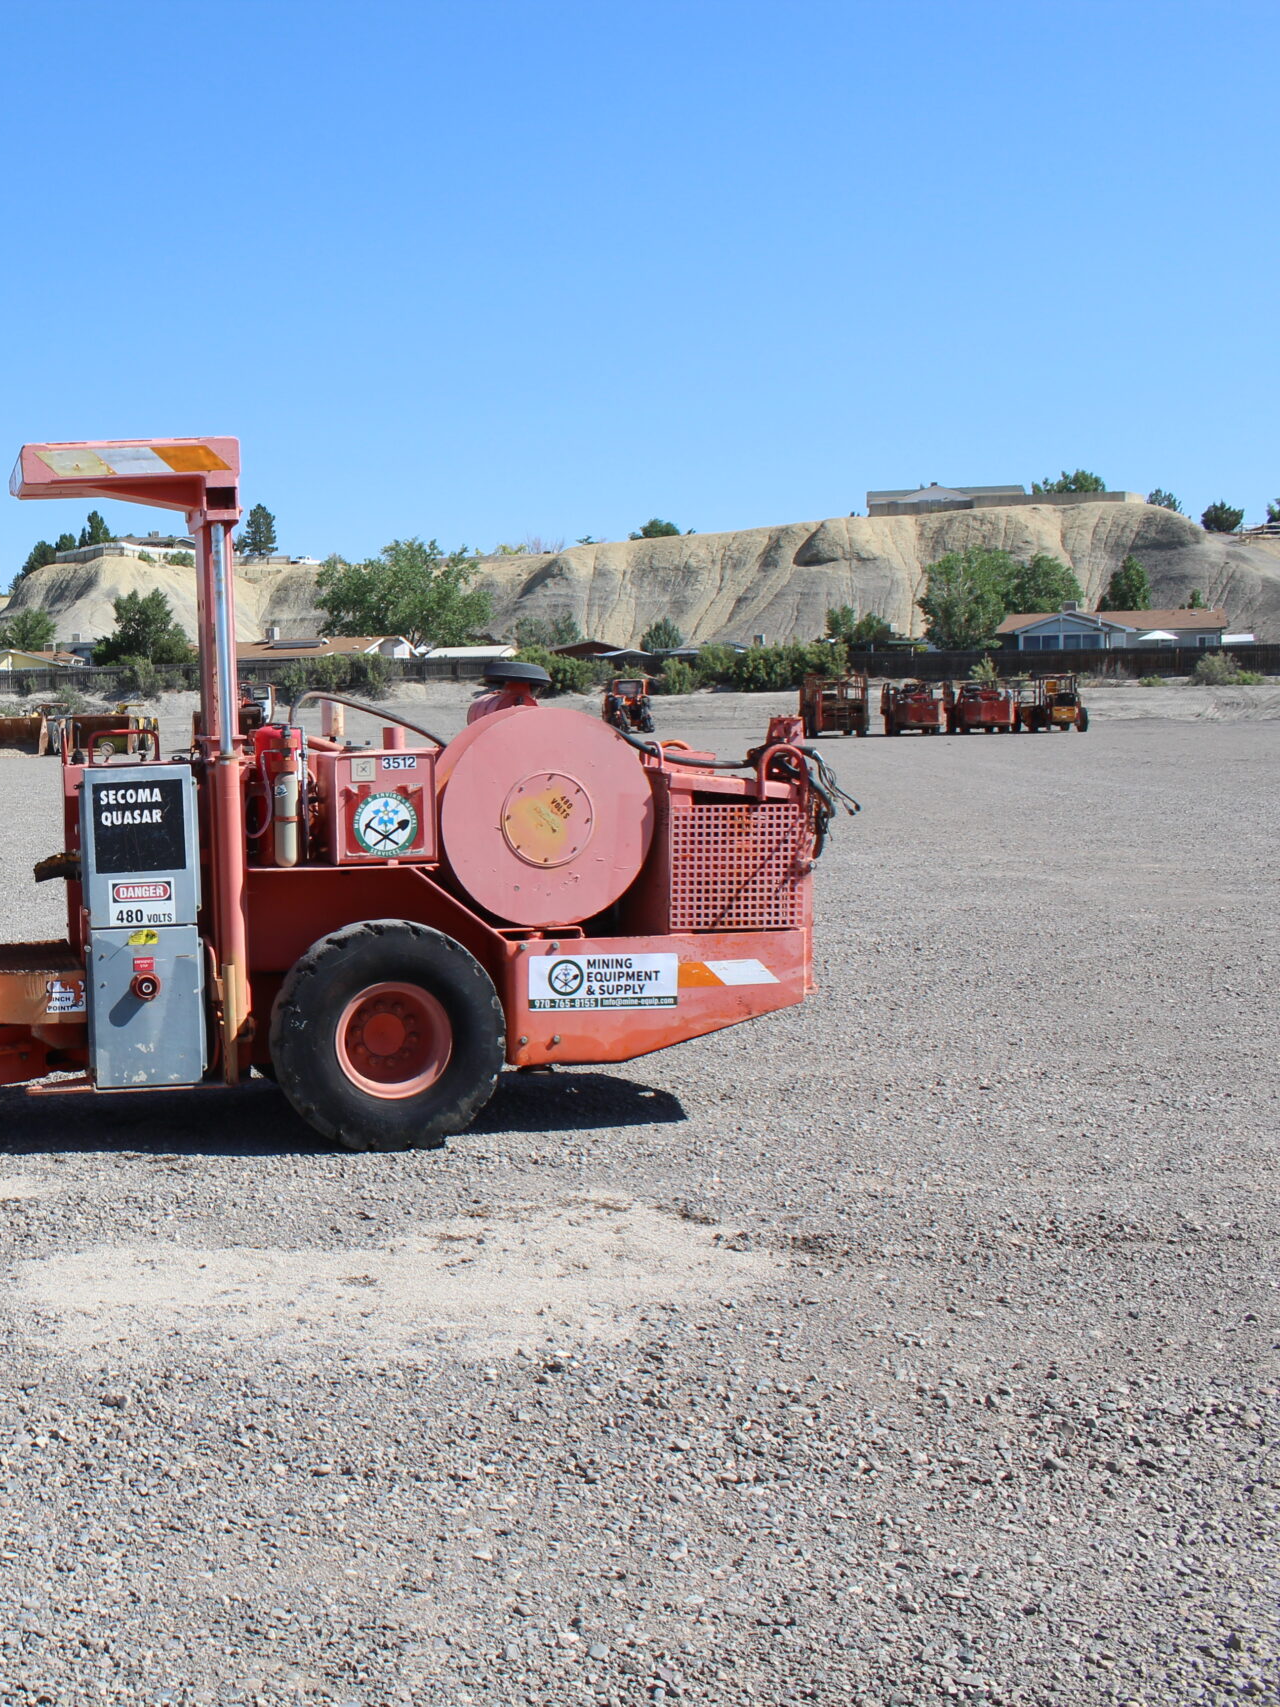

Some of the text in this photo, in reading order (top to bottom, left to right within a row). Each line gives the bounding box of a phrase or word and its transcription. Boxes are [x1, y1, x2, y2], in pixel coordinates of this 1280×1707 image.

[382, 757, 416, 769] 3512
[100, 788, 162, 805] SECOMA
[560, 796, 573, 809] 480
[551, 798, 570, 819] VOLTS
[101, 809, 163, 827] QUASAR
[119, 884, 164, 899] DANGER
[116, 908, 173, 924] 480 VOLTS
[586, 958, 633, 970] MINING
[586, 970, 661, 983] EQUIPMENT
[586, 983, 646, 996] & SUPPLY
[534, 999, 596, 1008] 970-765-8155
